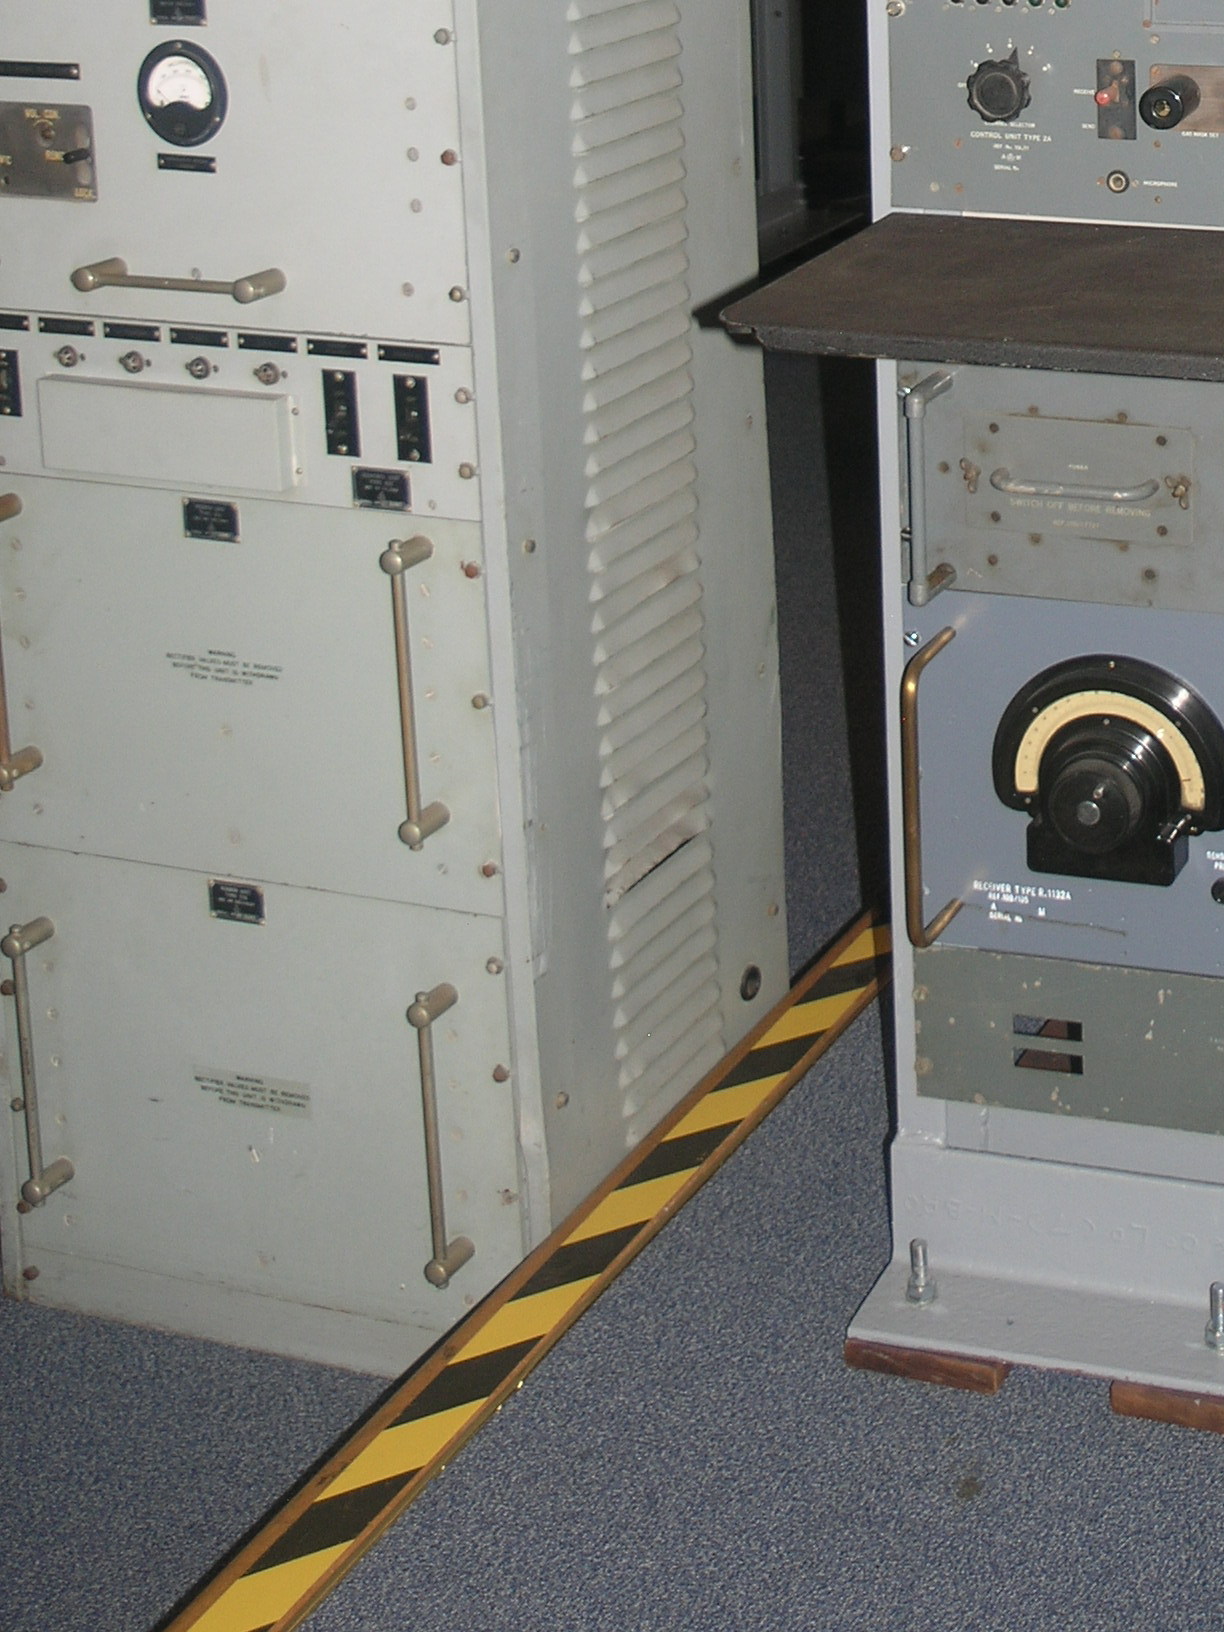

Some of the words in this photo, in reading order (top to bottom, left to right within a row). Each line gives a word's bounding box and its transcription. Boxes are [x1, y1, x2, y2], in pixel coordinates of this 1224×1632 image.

[970, 130, 1003, 140] CONTROL
[1023, 133, 1041, 142] TYPE
[972, 879, 1012, 894] RECEIVER
[1014, 884, 1036, 896] TYPE
